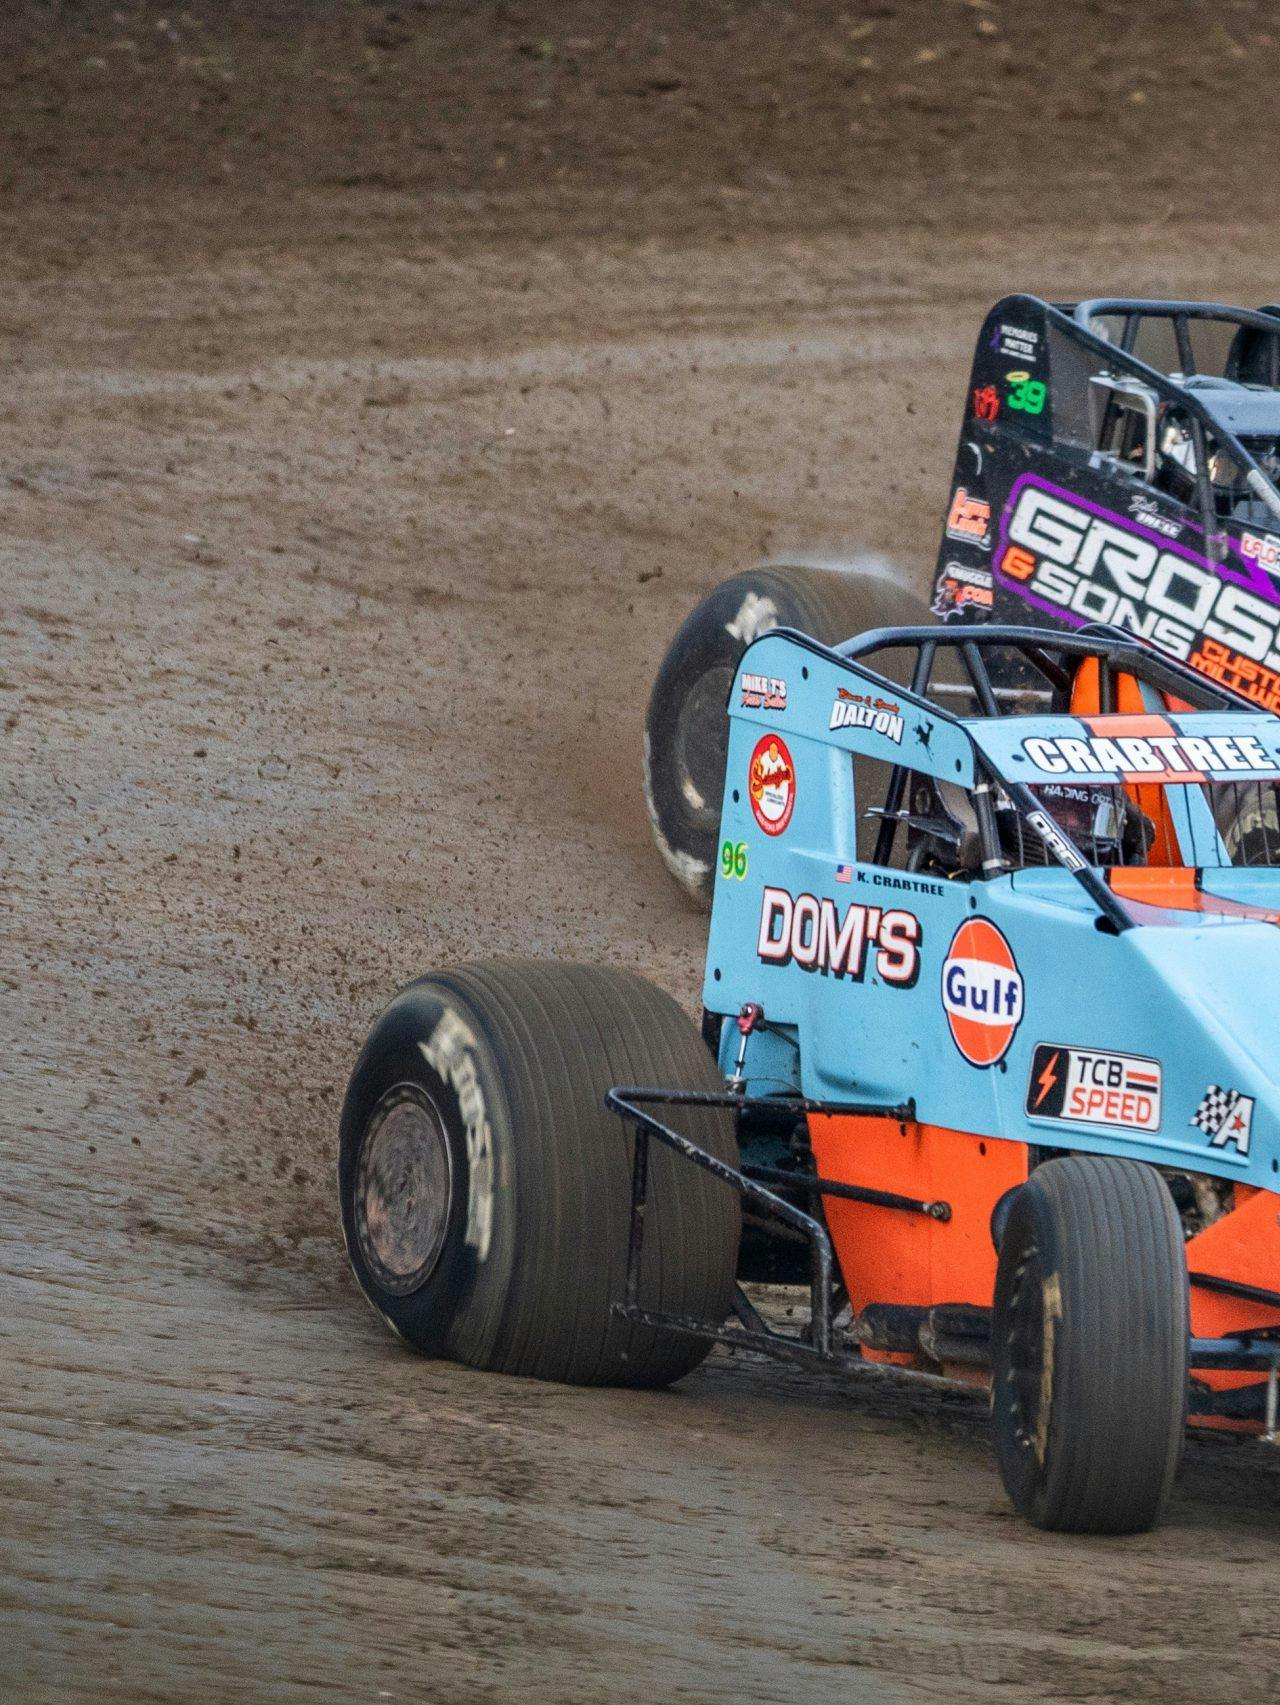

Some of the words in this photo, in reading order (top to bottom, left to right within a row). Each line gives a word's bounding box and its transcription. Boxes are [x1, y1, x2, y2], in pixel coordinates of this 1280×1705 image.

[1007, 379, 1047, 415] 39
[1031, 571, 1197, 660] SONS
[829, 700, 905, 746] DALTON
[1021, 736, 1280, 774] CRABTREE
[720, 840, 749, 880] 96
[857, 870, 870, 886] K.
[873, 874, 945, 897] CRABTREE
[757, 885, 923, 990] DOM'S
[946, 965, 1019, 1017] Gulf
[1076, 1055, 1123, 1087] TCB
[1069, 1087, 1153, 1124] SPEED
